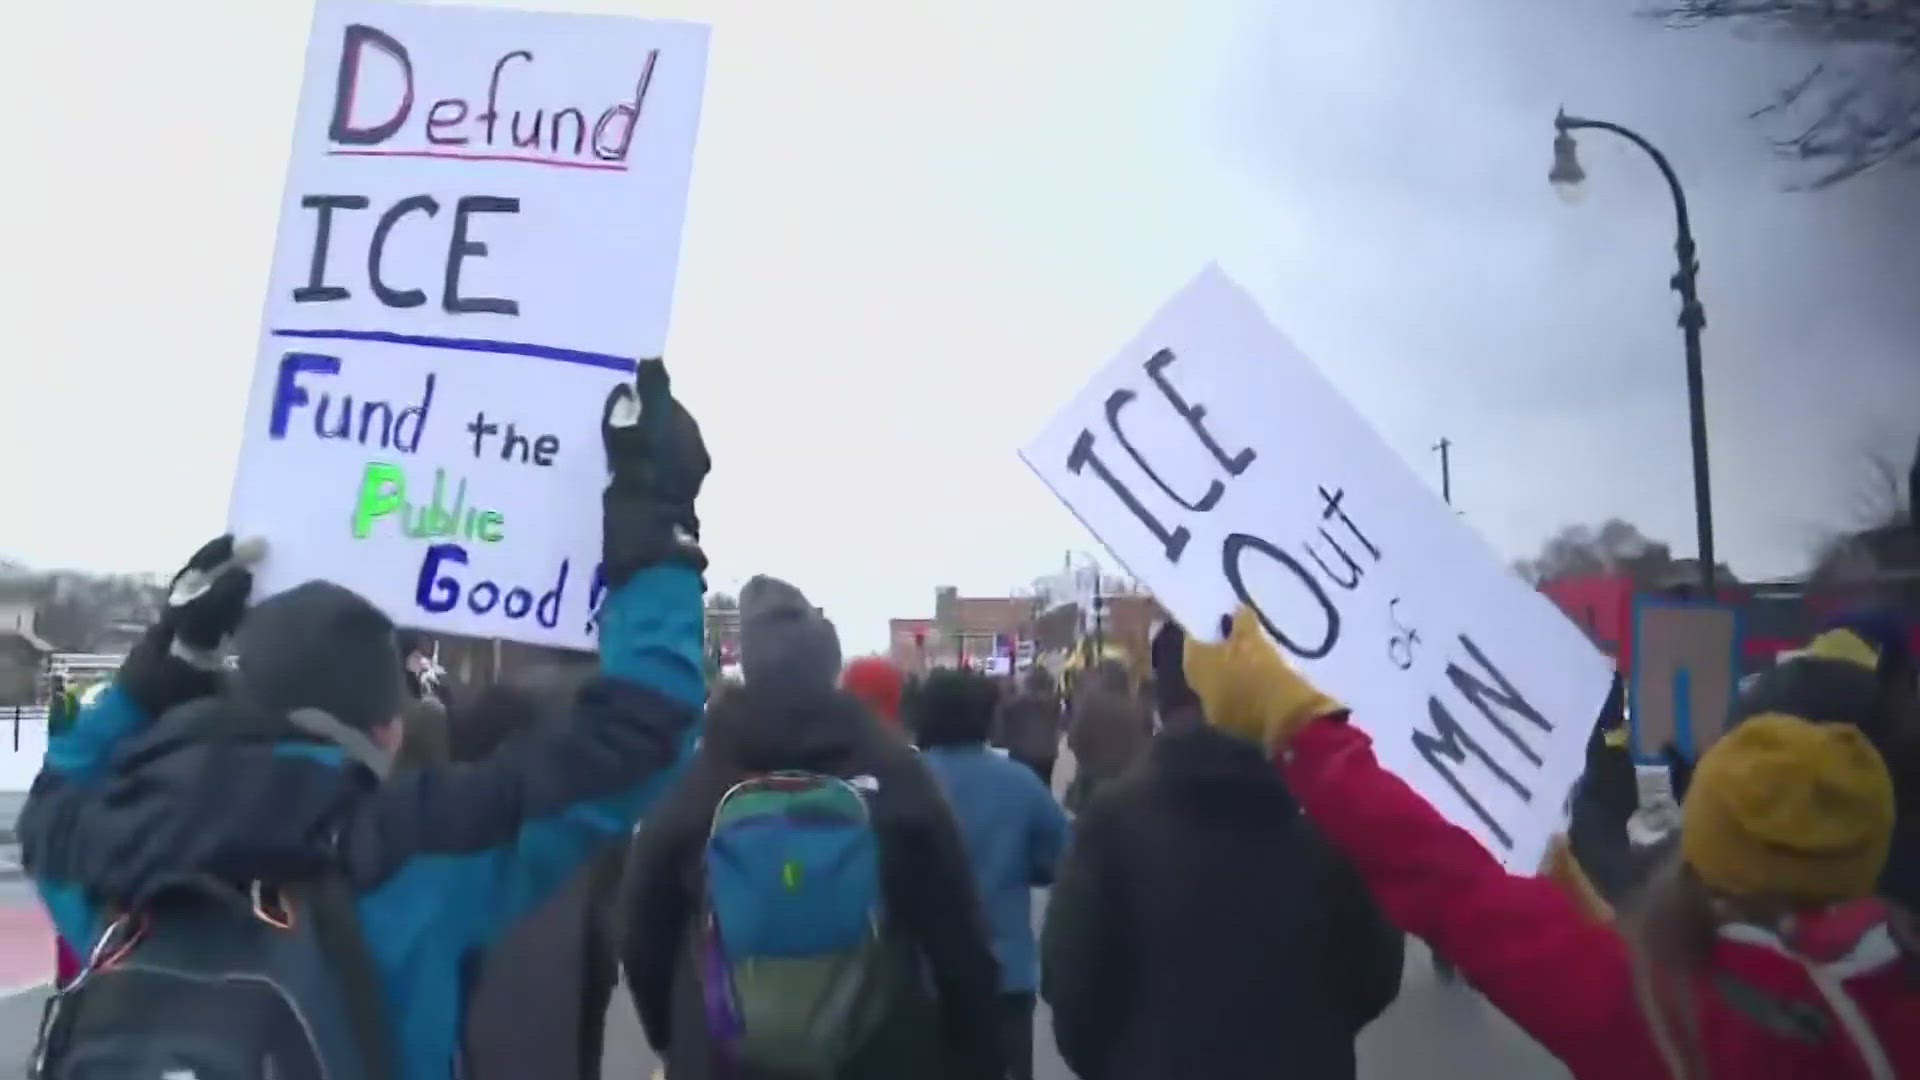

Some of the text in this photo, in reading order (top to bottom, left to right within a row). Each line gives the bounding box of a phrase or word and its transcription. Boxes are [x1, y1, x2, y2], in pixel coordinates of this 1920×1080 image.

[328, 24, 659, 161] Defund
[293, 194, 521, 316] ICE
[270, 352, 560, 466] Fund the
[1066, 347, 1257, 564] ICE
[1222, 485, 1381, 659] Out
[1388, 598, 1422, 670] of
[1412, 633, 1554, 849] MN
